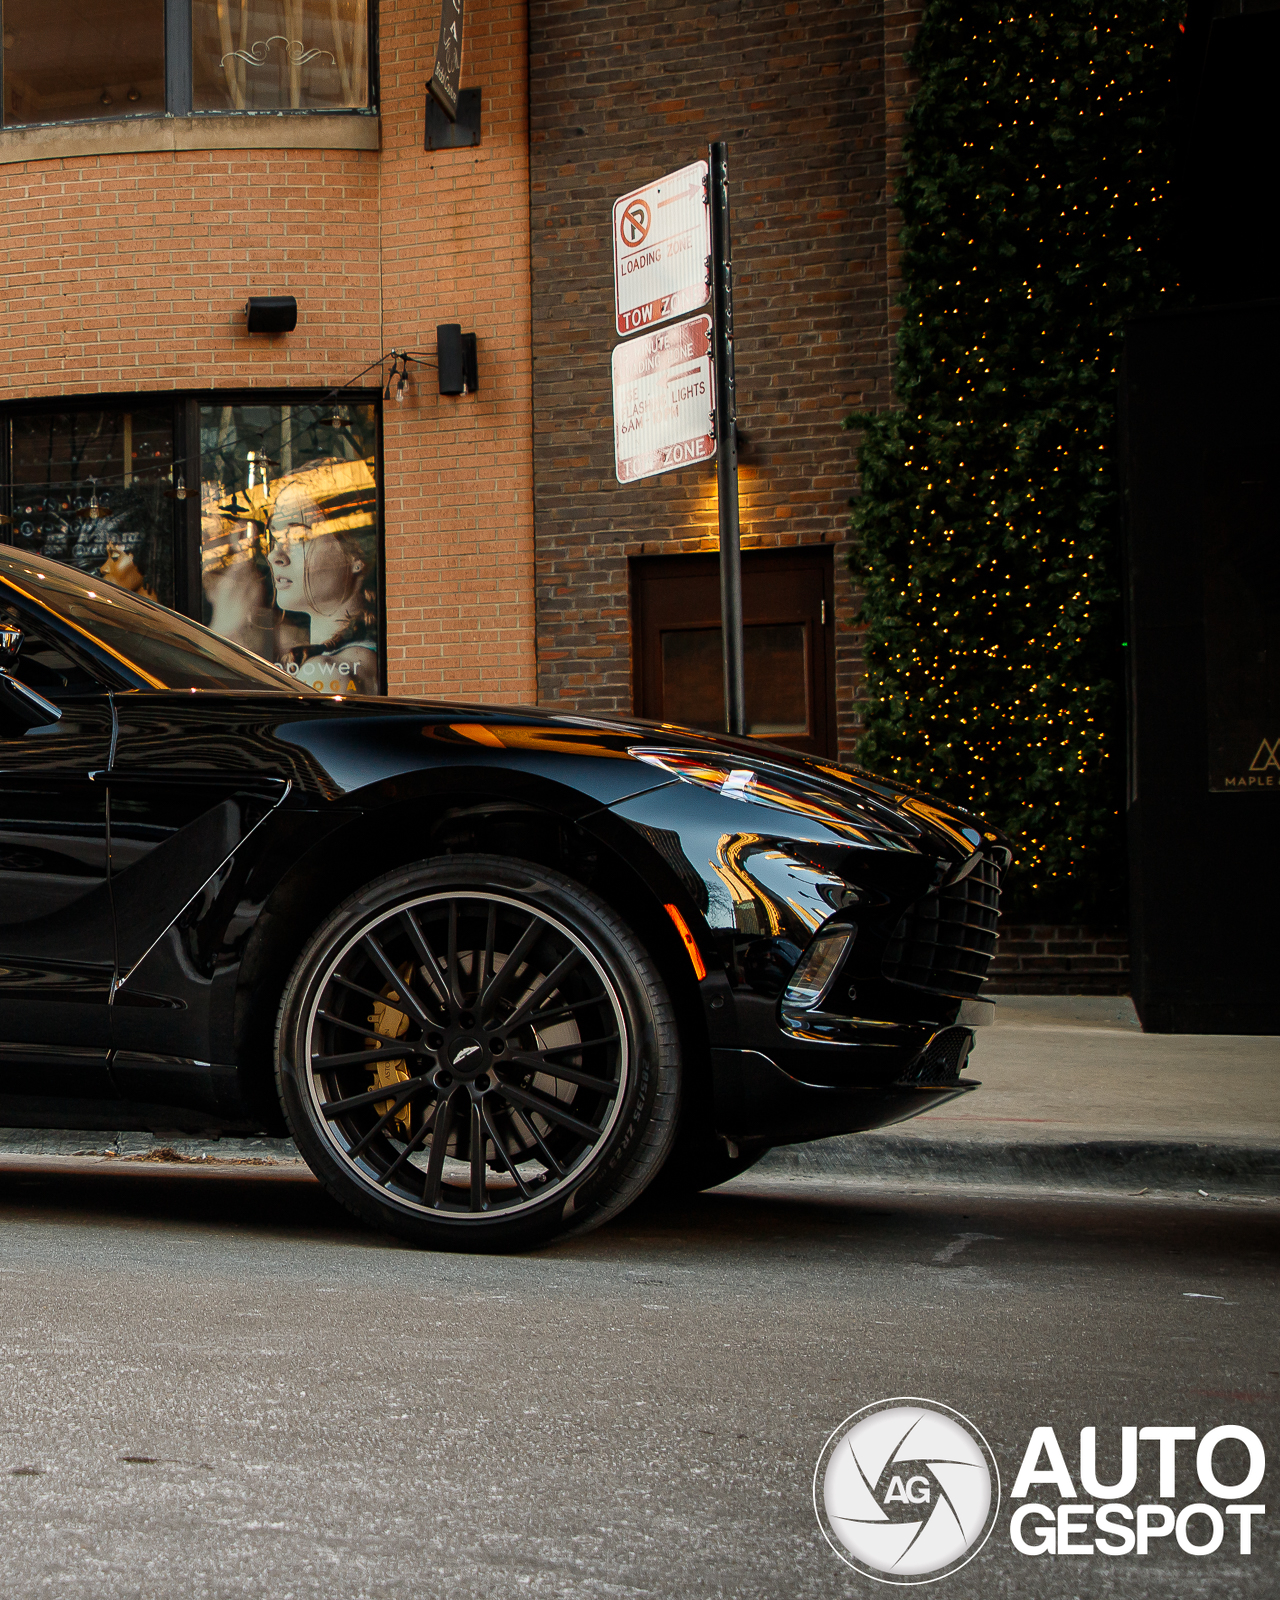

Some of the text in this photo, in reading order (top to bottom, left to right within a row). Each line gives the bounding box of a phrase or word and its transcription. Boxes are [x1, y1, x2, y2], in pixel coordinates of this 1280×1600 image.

[620, 235, 693, 277] LOADING ZONE
[622, 285, 701, 330] TOW ZONE
[634, 335, 671, 357] MINUTE
[668, 343, 694, 364] ZONE
[621, 380, 706, 420] FLASHING LIGHTS
[621, 416, 643, 434] 6AM
[623, 438, 706, 477] TOW ZONE
[304, 679, 357, 692] OGA
[1224, 775, 1274, 787] MAPLE
